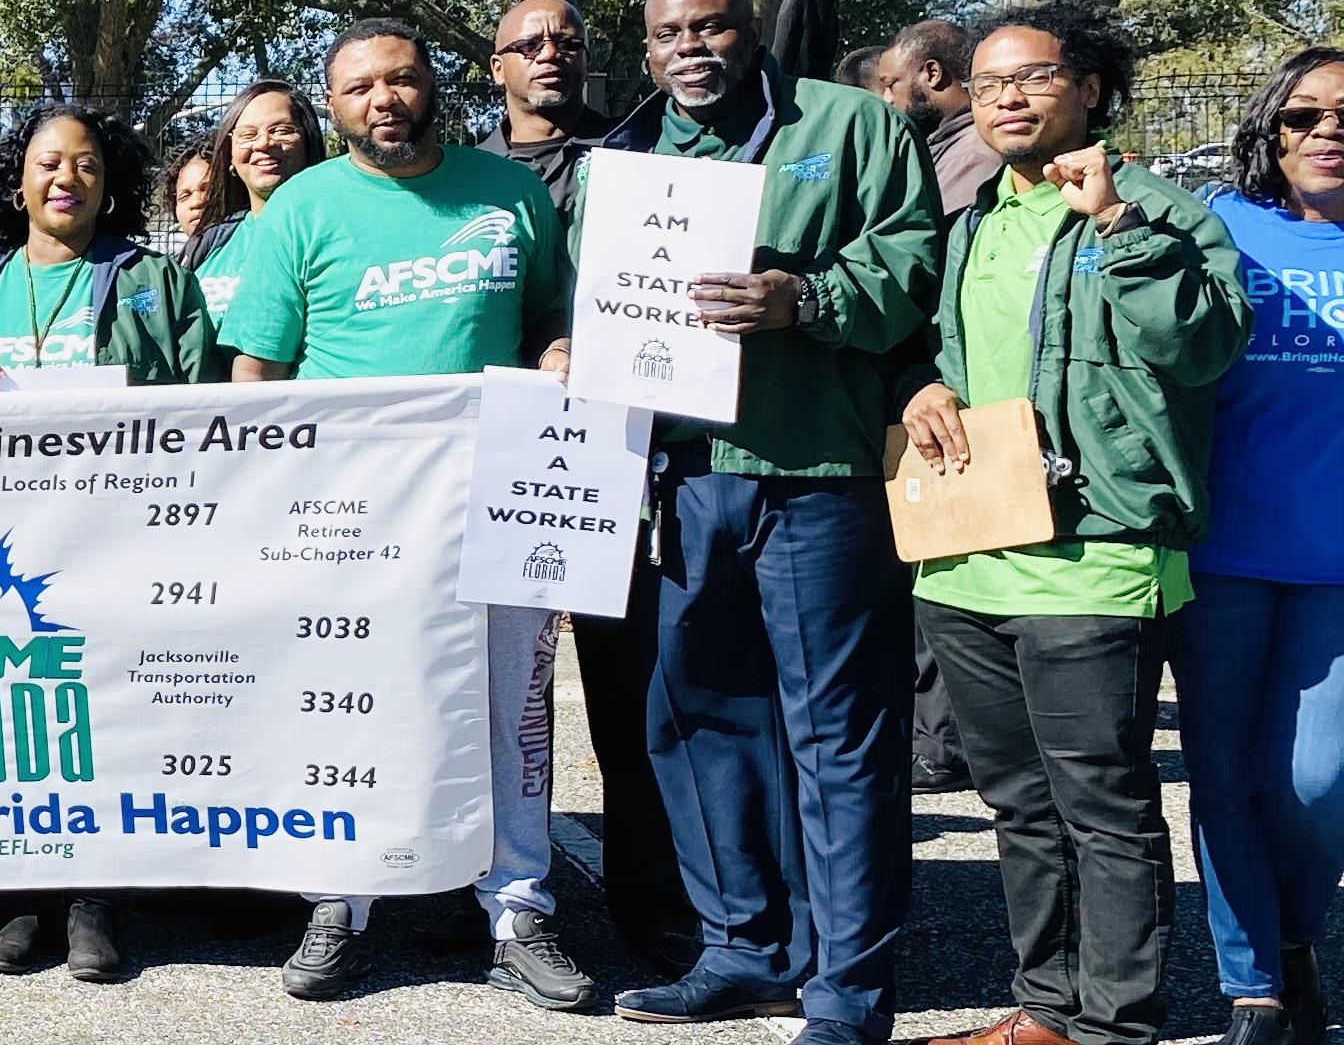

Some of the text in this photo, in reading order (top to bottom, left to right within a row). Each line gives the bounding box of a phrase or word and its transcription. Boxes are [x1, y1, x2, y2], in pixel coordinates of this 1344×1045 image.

[667, 183, 674, 198] I
[643, 213, 689, 232] AM
[652, 246, 672, 262] A
[354, 246, 519, 301] AFSCME
[355, 300, 377, 312] We
[380, 292, 417, 308] Make
[419, 282, 477, 300] America
[595, 298, 709, 329] WORKE
[1282, 298, 1344, 330] HO
[1247, 334, 1336, 347] FLOR
[563, 397, 570, 412] I
[198, 415, 318, 452] Area
[538, 425, 587, 444] AM
[546, 455, 569, 472] A
[1, 474, 67, 492] Locals
[74, 473, 99, 495] of
[104, 473, 178, 494] Region
[510, 480, 600, 504] STATE
[146, 502, 219, 527] 2897
[288, 500, 368, 515] AFSCME
[298, 524, 362, 538] Retiree
[487, 506, 617, 535] WORKER
[260, 545, 401, 565] Sub-Chapter 42
[150, 581, 218, 605] 2941
[296, 616, 371, 640] 3038
[138, 650, 240, 666] Jacksonville
[128, 670, 256, 687] Transportation
[151, 691, 234, 709] Authority
[300, 690, 374, 715] 3340
[161, 754, 232, 777] 3025
[304, 764, 377, 789] 3344
[120, 792, 356, 850] Happen
